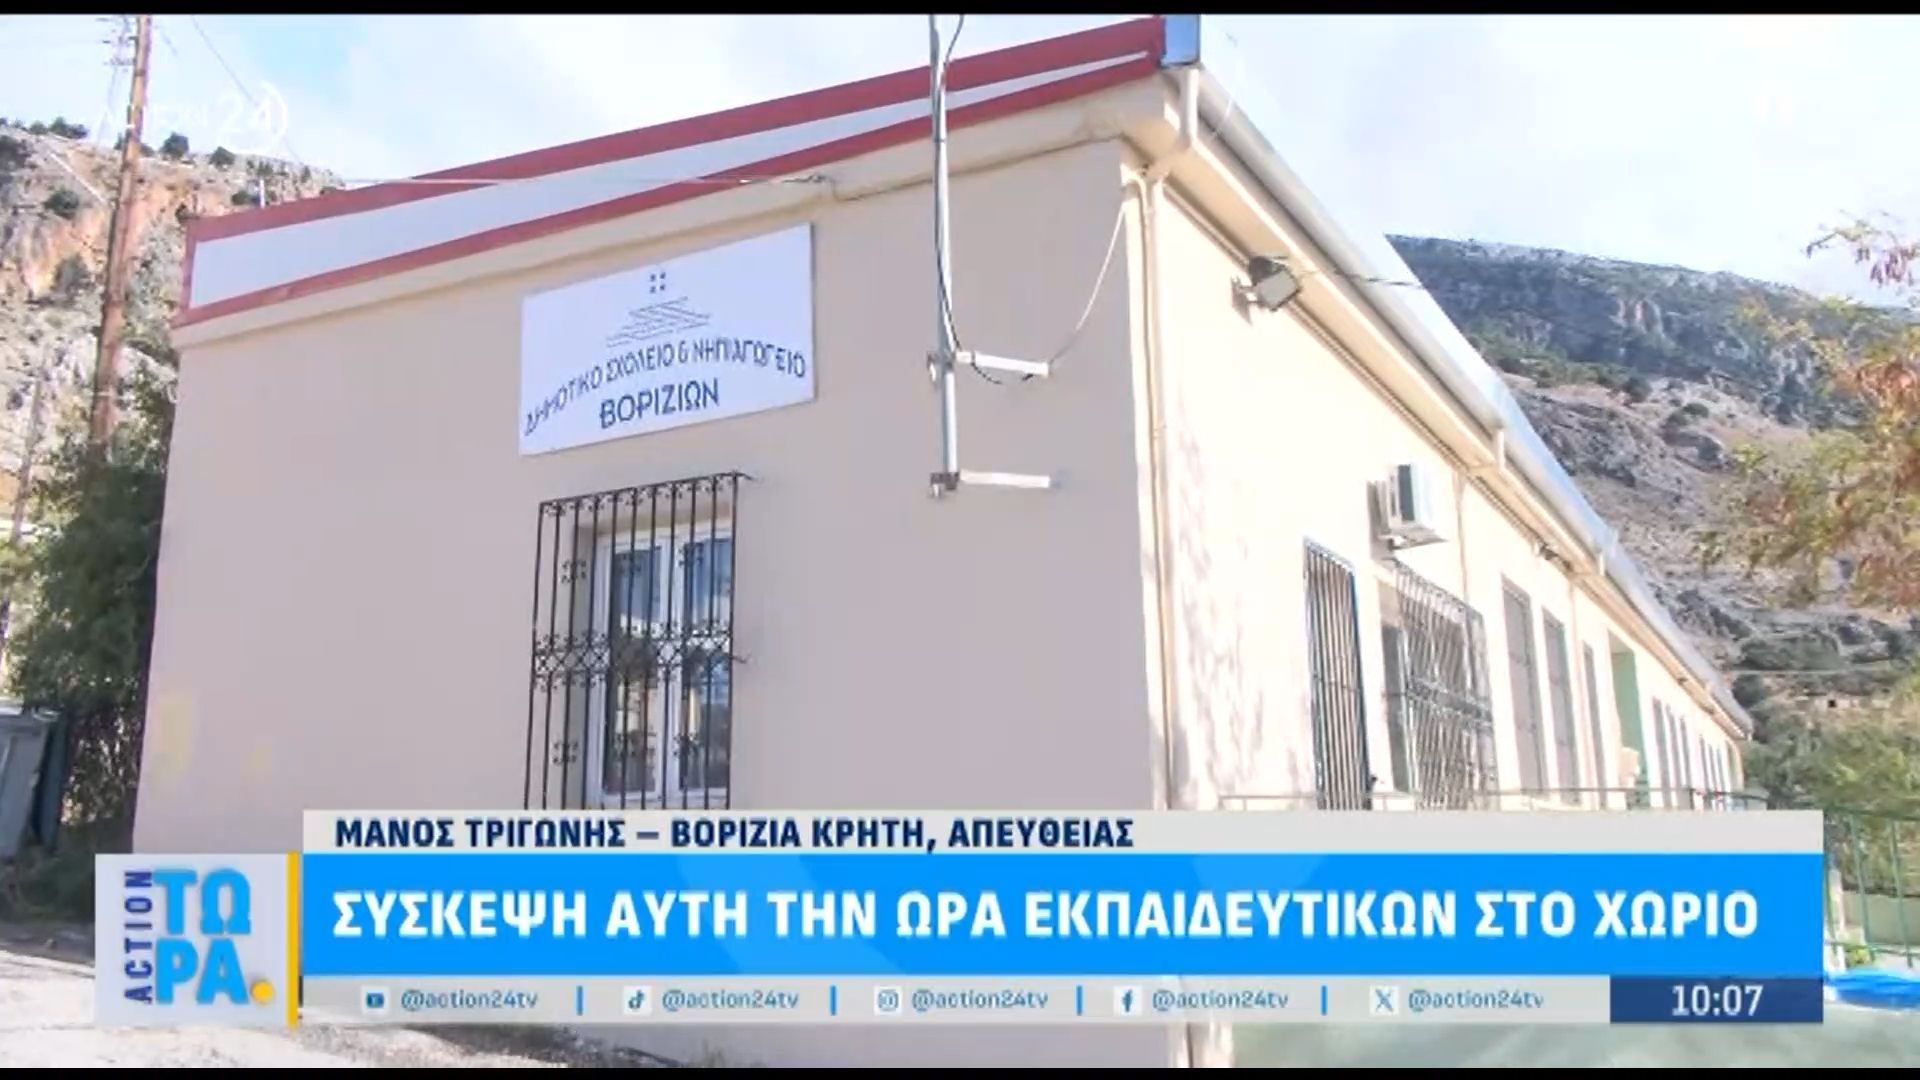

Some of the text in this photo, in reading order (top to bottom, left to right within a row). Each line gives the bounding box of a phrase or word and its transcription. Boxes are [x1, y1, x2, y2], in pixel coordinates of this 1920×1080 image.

[524, 365, 604, 437] ΔΗΜΟΤΙΚΟ
[605, 343, 675, 383] ΣΧΟΛΕΙΟ
[692, 336, 806, 379] ΝΗΠΙΑΓΩΓΕΙΟ
[599, 377, 720, 430] ΒΟΡΙΖΙΩΝ
